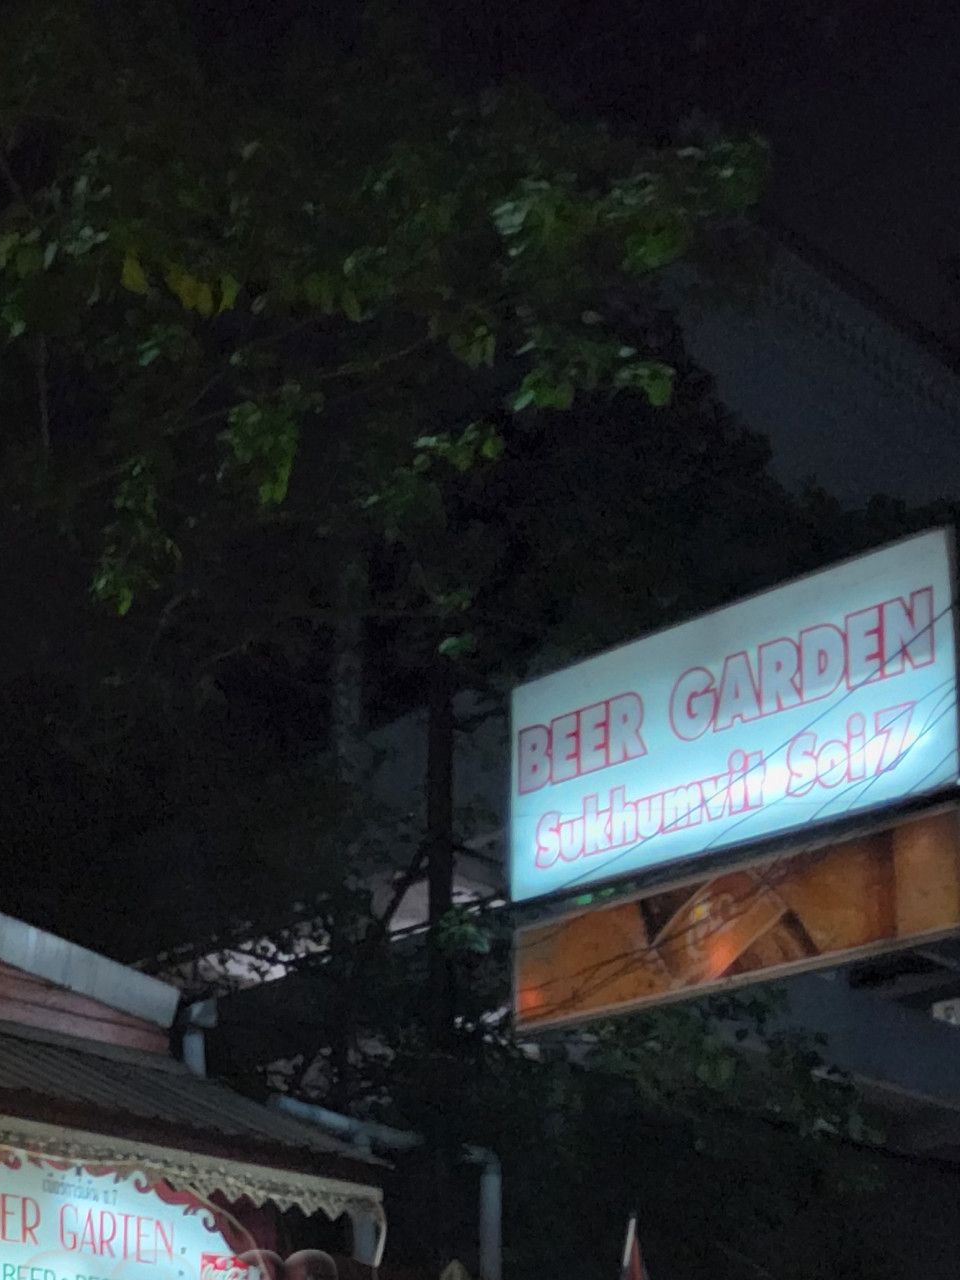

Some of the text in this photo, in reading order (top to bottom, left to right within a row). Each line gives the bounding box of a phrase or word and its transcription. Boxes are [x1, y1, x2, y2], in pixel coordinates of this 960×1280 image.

[518, 586, 935, 796] BEER GARDEN
[534, 749, 767, 870] Sukhumvit
[58, 1203, 174, 1265] GARTEN
